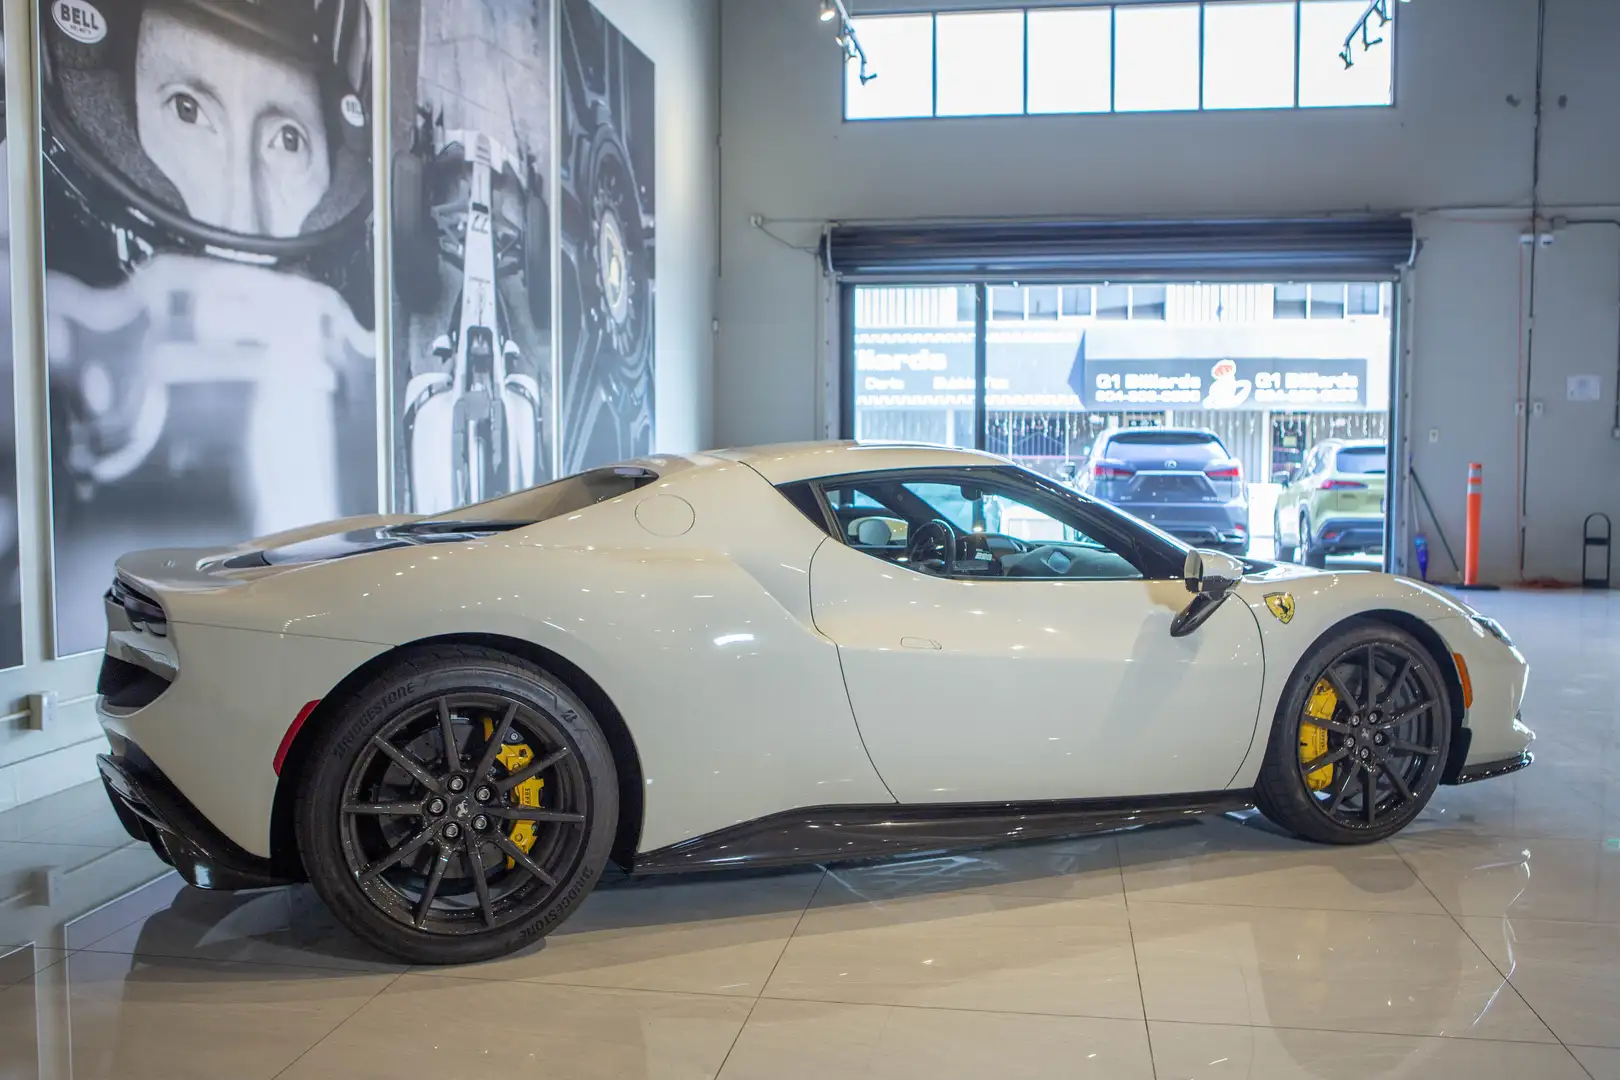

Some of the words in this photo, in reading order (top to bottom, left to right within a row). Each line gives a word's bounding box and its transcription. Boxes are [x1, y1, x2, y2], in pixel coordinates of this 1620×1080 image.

[60, 3, 99, 30] BELL
[334, 681, 416, 759] BRIDGESTONE
[518, 865, 594, 940] BRIDGESTONE
